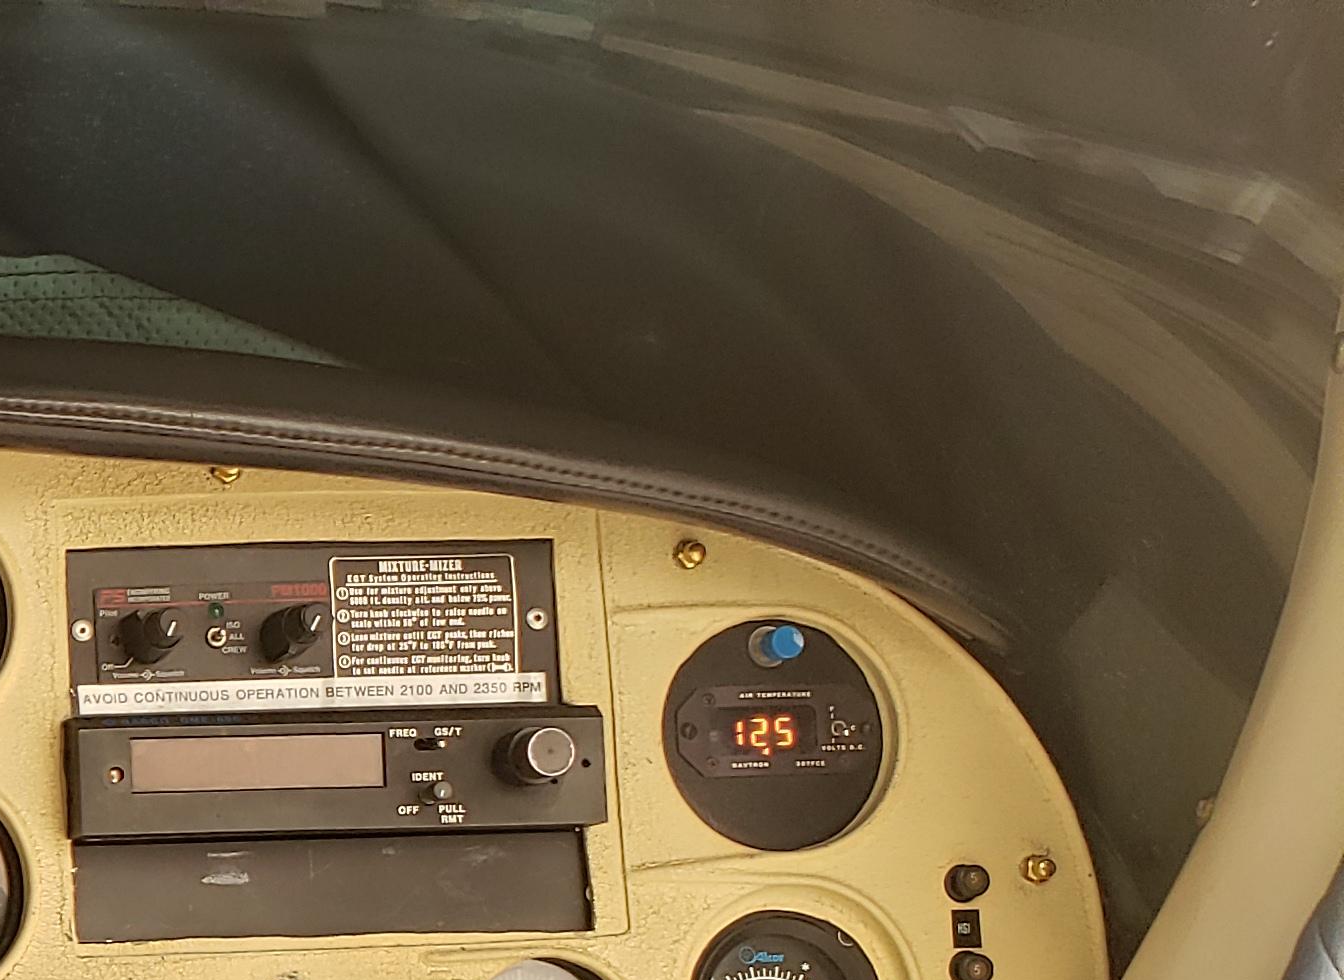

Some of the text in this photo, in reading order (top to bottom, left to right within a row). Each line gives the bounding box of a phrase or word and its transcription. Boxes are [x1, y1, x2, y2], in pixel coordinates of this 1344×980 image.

[379, 560, 463, 573] MIXTURE-MIZER
[199, 591, 230, 601] POWER
[83, 681, 542, 706] AVOID CONTINUOUS OPERATION BETWEEN 2100 AND 2350 RPM
[755, 690, 811, 698] TEMPERATURE
[389, 728, 417, 739] FREQ
[434, 726, 462, 738] GS/T
[412, 772, 443, 782] IDENT
[398, 805, 419, 816] OFF
[438, 804, 465, 815] PULL
[441, 814, 464, 824] RMT
